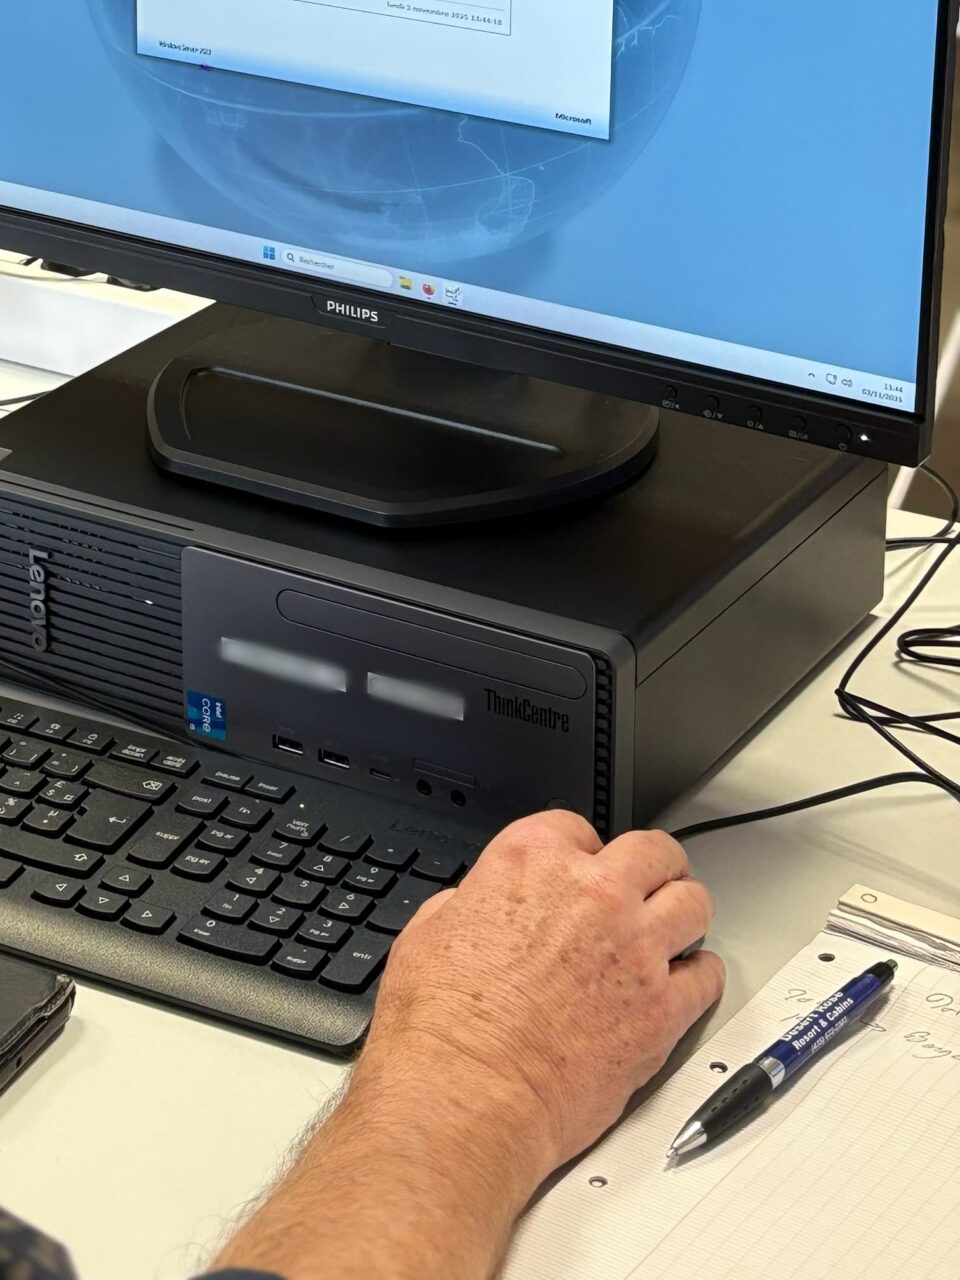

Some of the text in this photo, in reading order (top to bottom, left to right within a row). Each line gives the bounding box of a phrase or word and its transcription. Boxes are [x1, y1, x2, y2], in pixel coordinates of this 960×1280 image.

[326, 300, 379, 323] PHILIPS
[28, 548, 49, 653] Lenovo
[483, 687, 571, 733] ThinkCentre
[352, 951, 372, 960] entr
[791, 1025, 821, 1051] Resort
[818, 1018, 828, 1028] &
[826, 997, 854, 1021] Cabins
